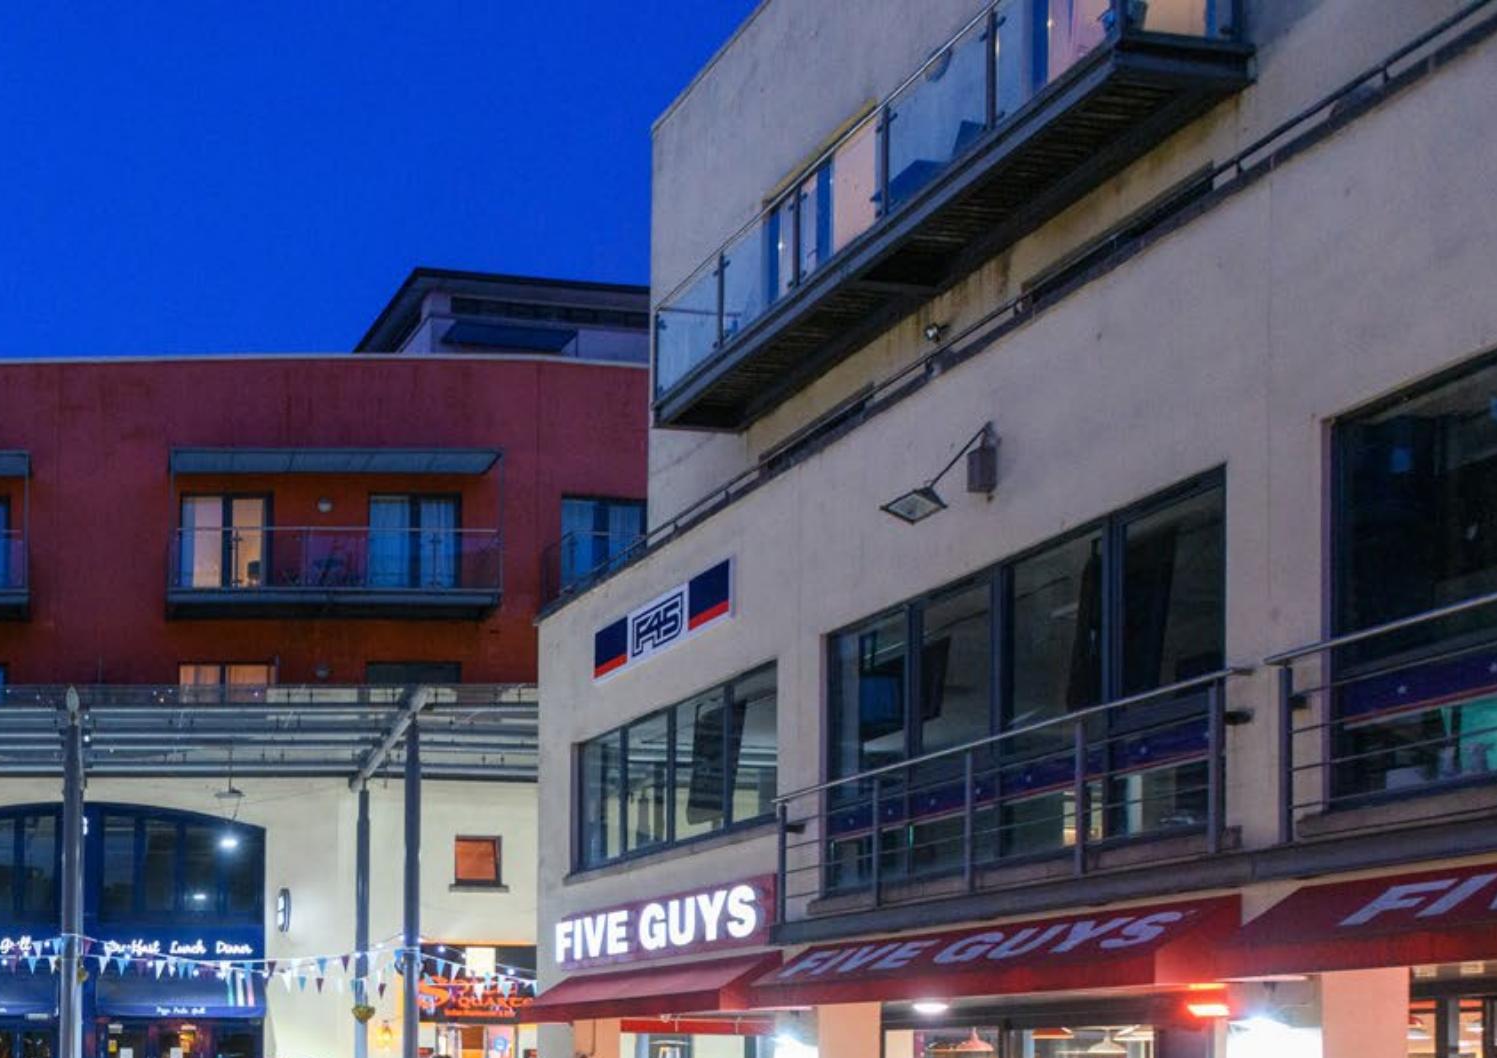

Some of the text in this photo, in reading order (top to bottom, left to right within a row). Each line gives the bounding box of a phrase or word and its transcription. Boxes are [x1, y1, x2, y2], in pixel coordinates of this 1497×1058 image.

[634, 596, 682, 654] F45
[555, 884, 757, 964] FIVE GUYS
[1338, 872, 1497, 927] FI
[169, 939, 207, 955] Lunch
[215, 940, 254, 955] Dinner
[777, 911, 1186, 979] FIVE GUYS
